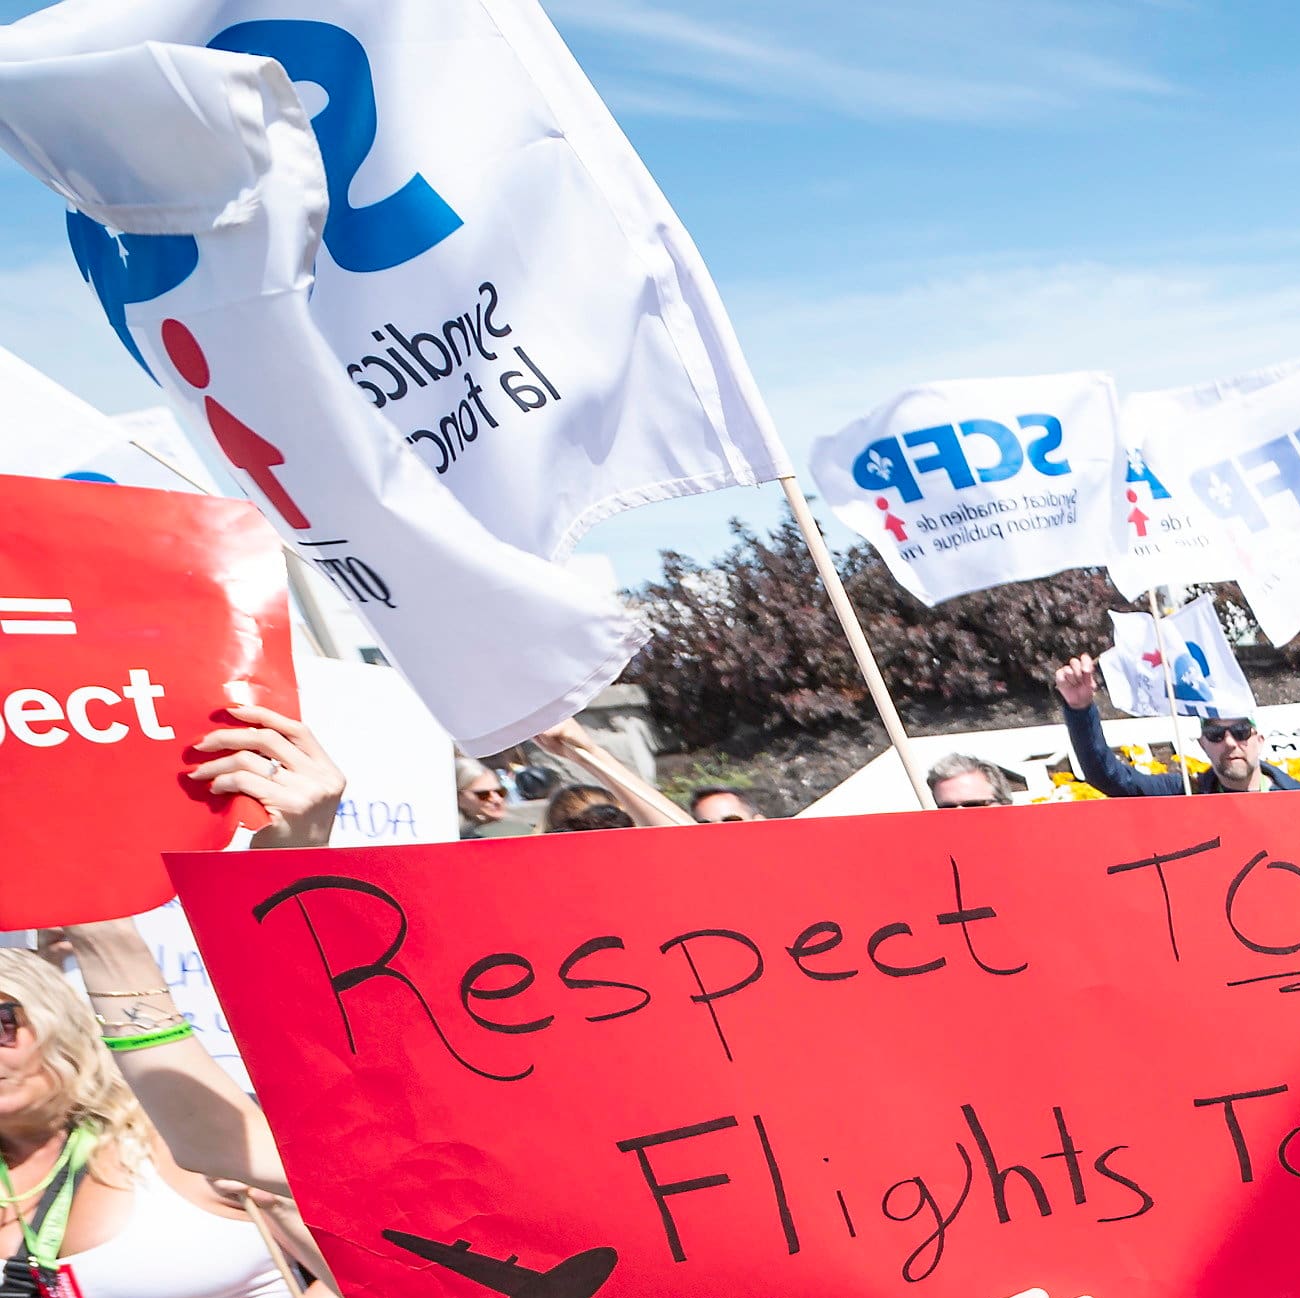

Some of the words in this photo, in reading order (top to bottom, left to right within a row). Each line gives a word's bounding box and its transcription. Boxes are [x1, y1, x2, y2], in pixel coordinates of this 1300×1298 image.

[0, 668, 176, 748] ect
[251, 856, 1028, 1081] Respect
[616, 1104, 1154, 1282] Flights
